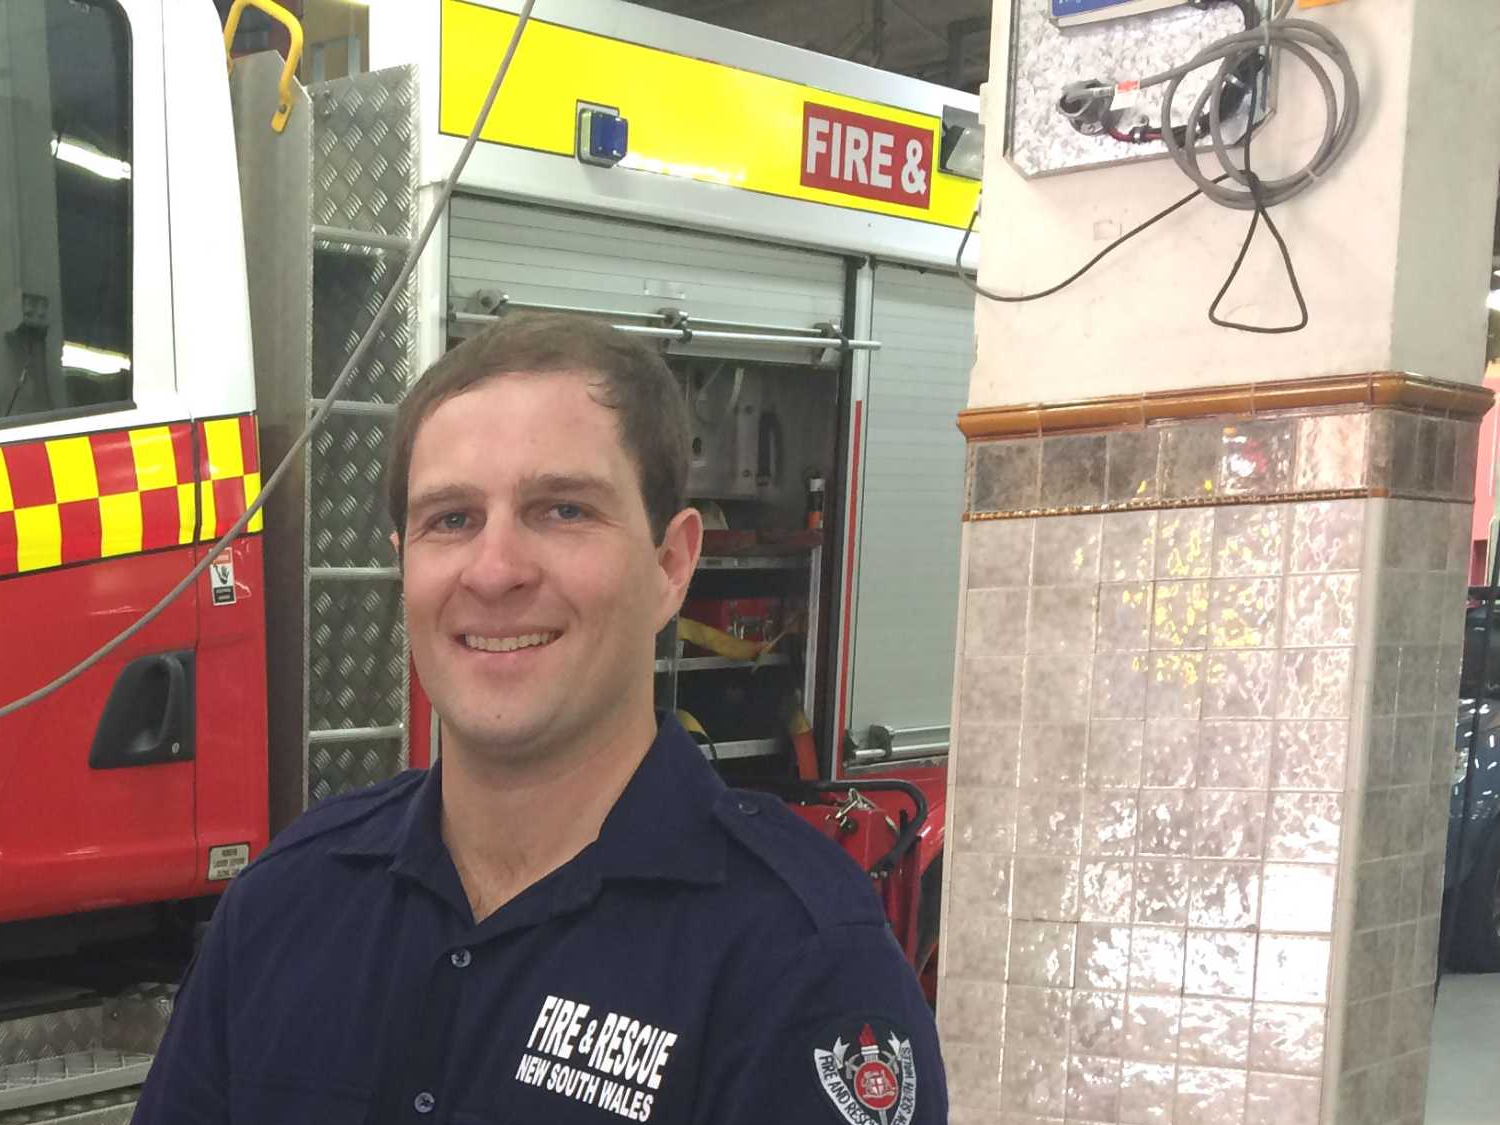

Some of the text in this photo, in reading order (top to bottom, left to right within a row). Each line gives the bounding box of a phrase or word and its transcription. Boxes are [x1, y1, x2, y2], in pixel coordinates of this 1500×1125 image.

[806, 116, 927, 195] FIRE &
[526, 995, 678, 1090] FIRE & RESCUE
[515, 1054, 654, 1122] NEW SOUTH WALES
[819, 1055, 837, 1080] FIRE
[828, 1081, 851, 1105] AND
